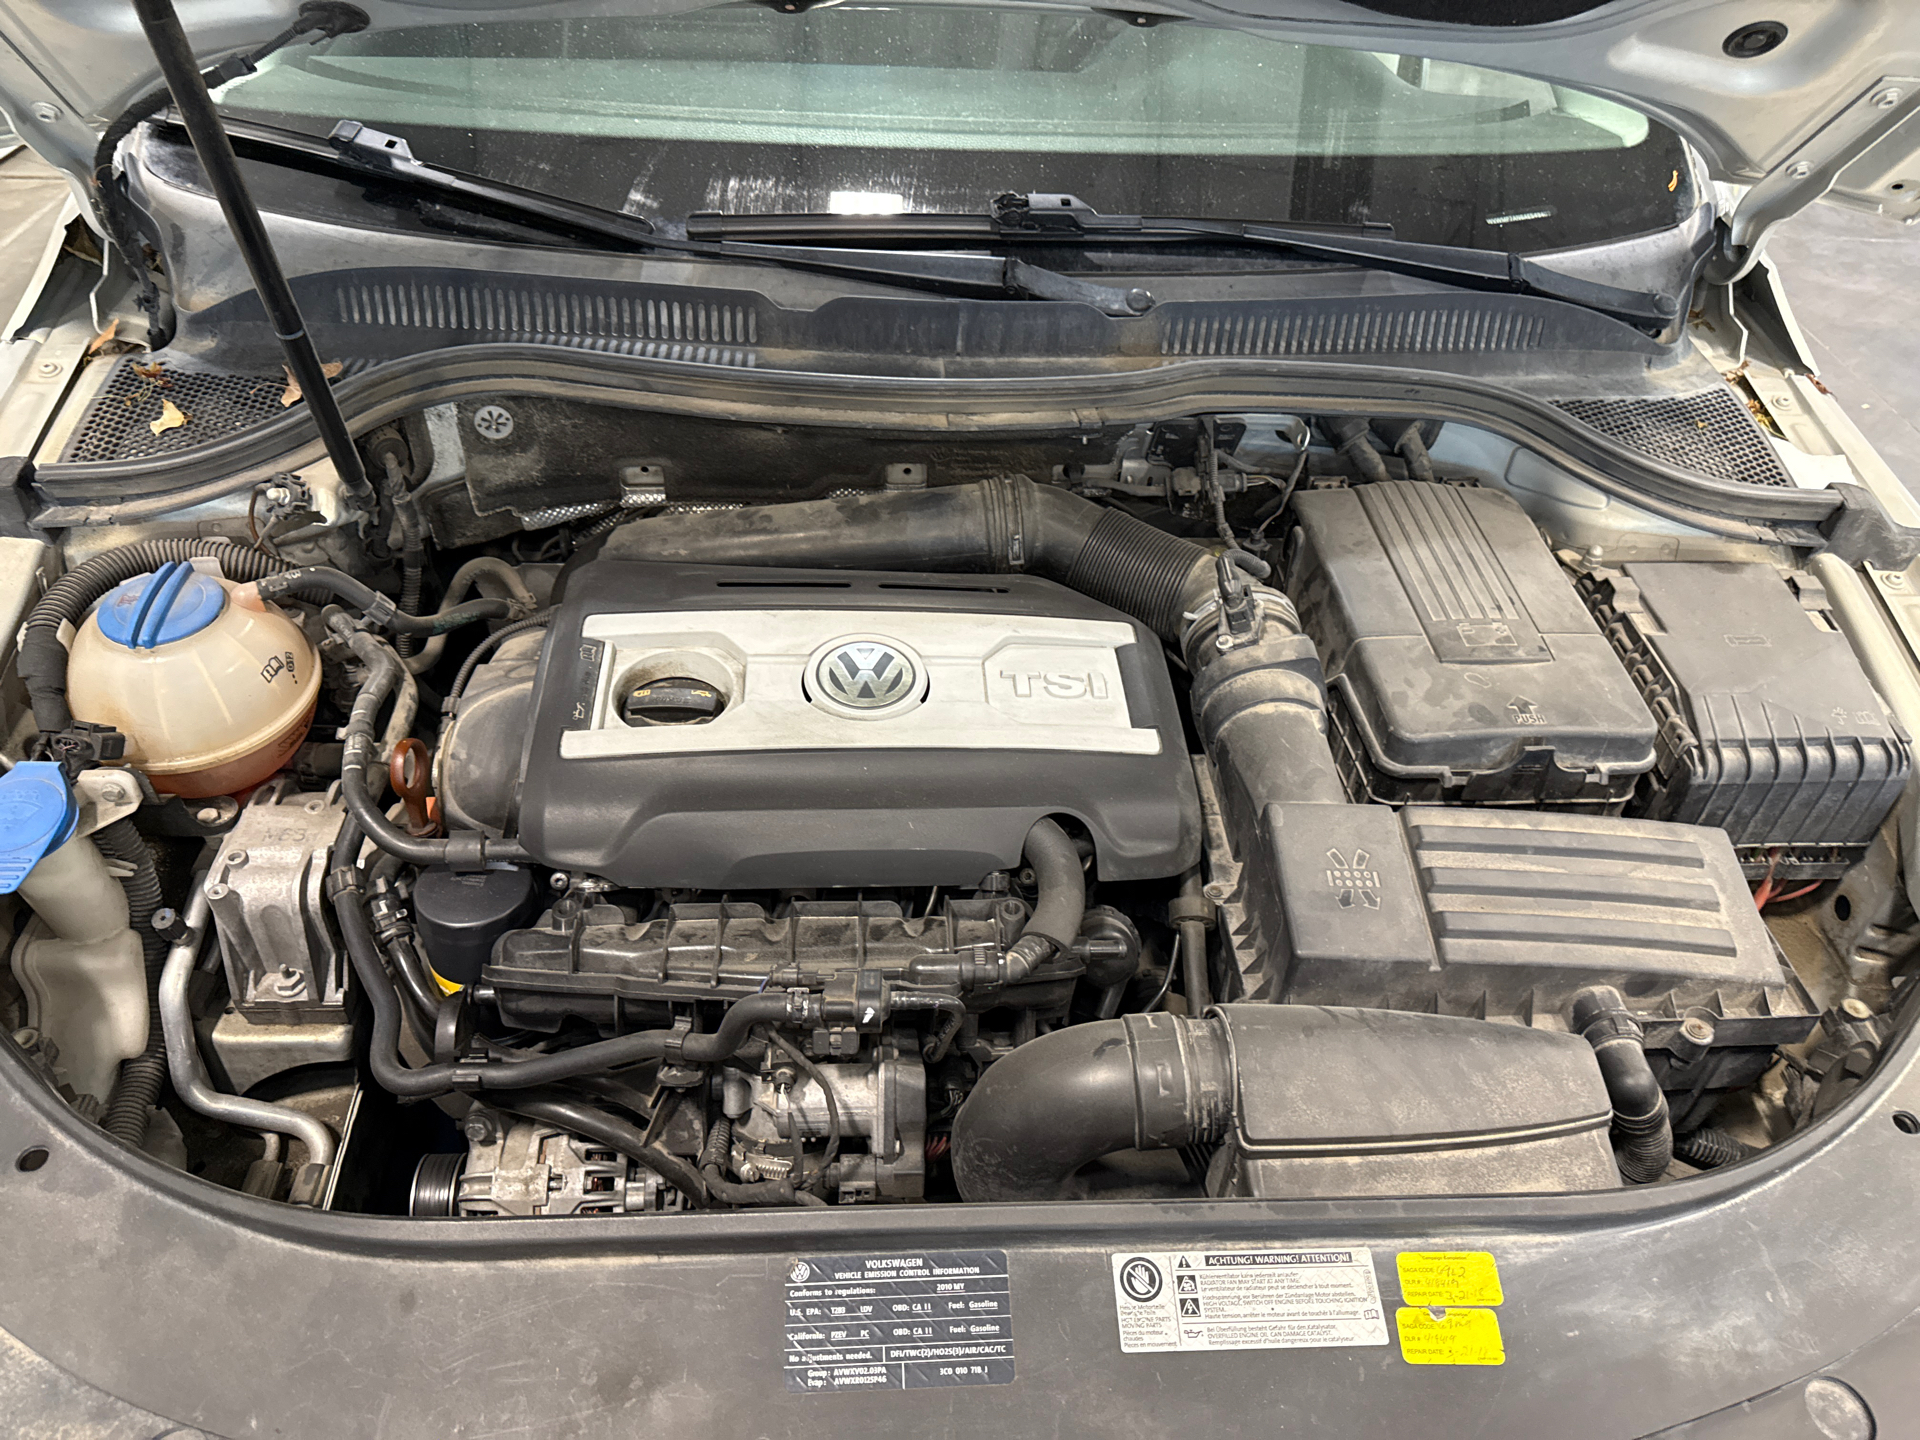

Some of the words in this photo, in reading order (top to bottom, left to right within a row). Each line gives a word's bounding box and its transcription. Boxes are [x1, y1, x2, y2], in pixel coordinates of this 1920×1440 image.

[1000, 670, 1108, 699] TSI
[1512, 714, 1547, 724] PUSH
[865, 1257, 923, 1269] VOLKSWAGEN
[1208, 1255, 1253, 1266] ACHTUNG!
[1254, 1254, 1299, 1265] WARNING!
[1300, 1252, 1351, 1263] ATTENTION!
[834, 1271, 862, 1280] VEHICLE
[864, 1269, 897, 1279] EMISSION
[899, 1268, 931, 1277] CONTROL
[932, 1266, 980, 1276] INFORMATION
[789, 1289, 822, 1298] Conforms
[824, 1288, 833, 1296] to
[834, 1286, 876, 1297] regulations:
[936, 1283, 953, 1291] 2010
[953, 1282, 965, 1290] MY
[805, 1307, 822, 1316] EPA:
[860, 1305, 873, 1313] LDV
[892, 1303, 910, 1312] OBD:
[912, 1303, 922, 1311] CA
[947, 1301, 966, 1310] Fuel:
[969, 1299, 998, 1309] Gasoline
[789, 1331, 826, 1341] California:
[831, 1330, 848, 1338] PZEV
[860, 1329, 870, 1337] PC
[892, 1327, 911, 1336] OBD:
[912, 1327, 923, 1335] CA
[949, 1325, 967, 1334] Fuel:
[970, 1323, 1000, 1333] Gasoline
[788, 1353, 800, 1362] No
[845, 1351, 872, 1360] needed.
[955, 1366, 968, 1375] 010
